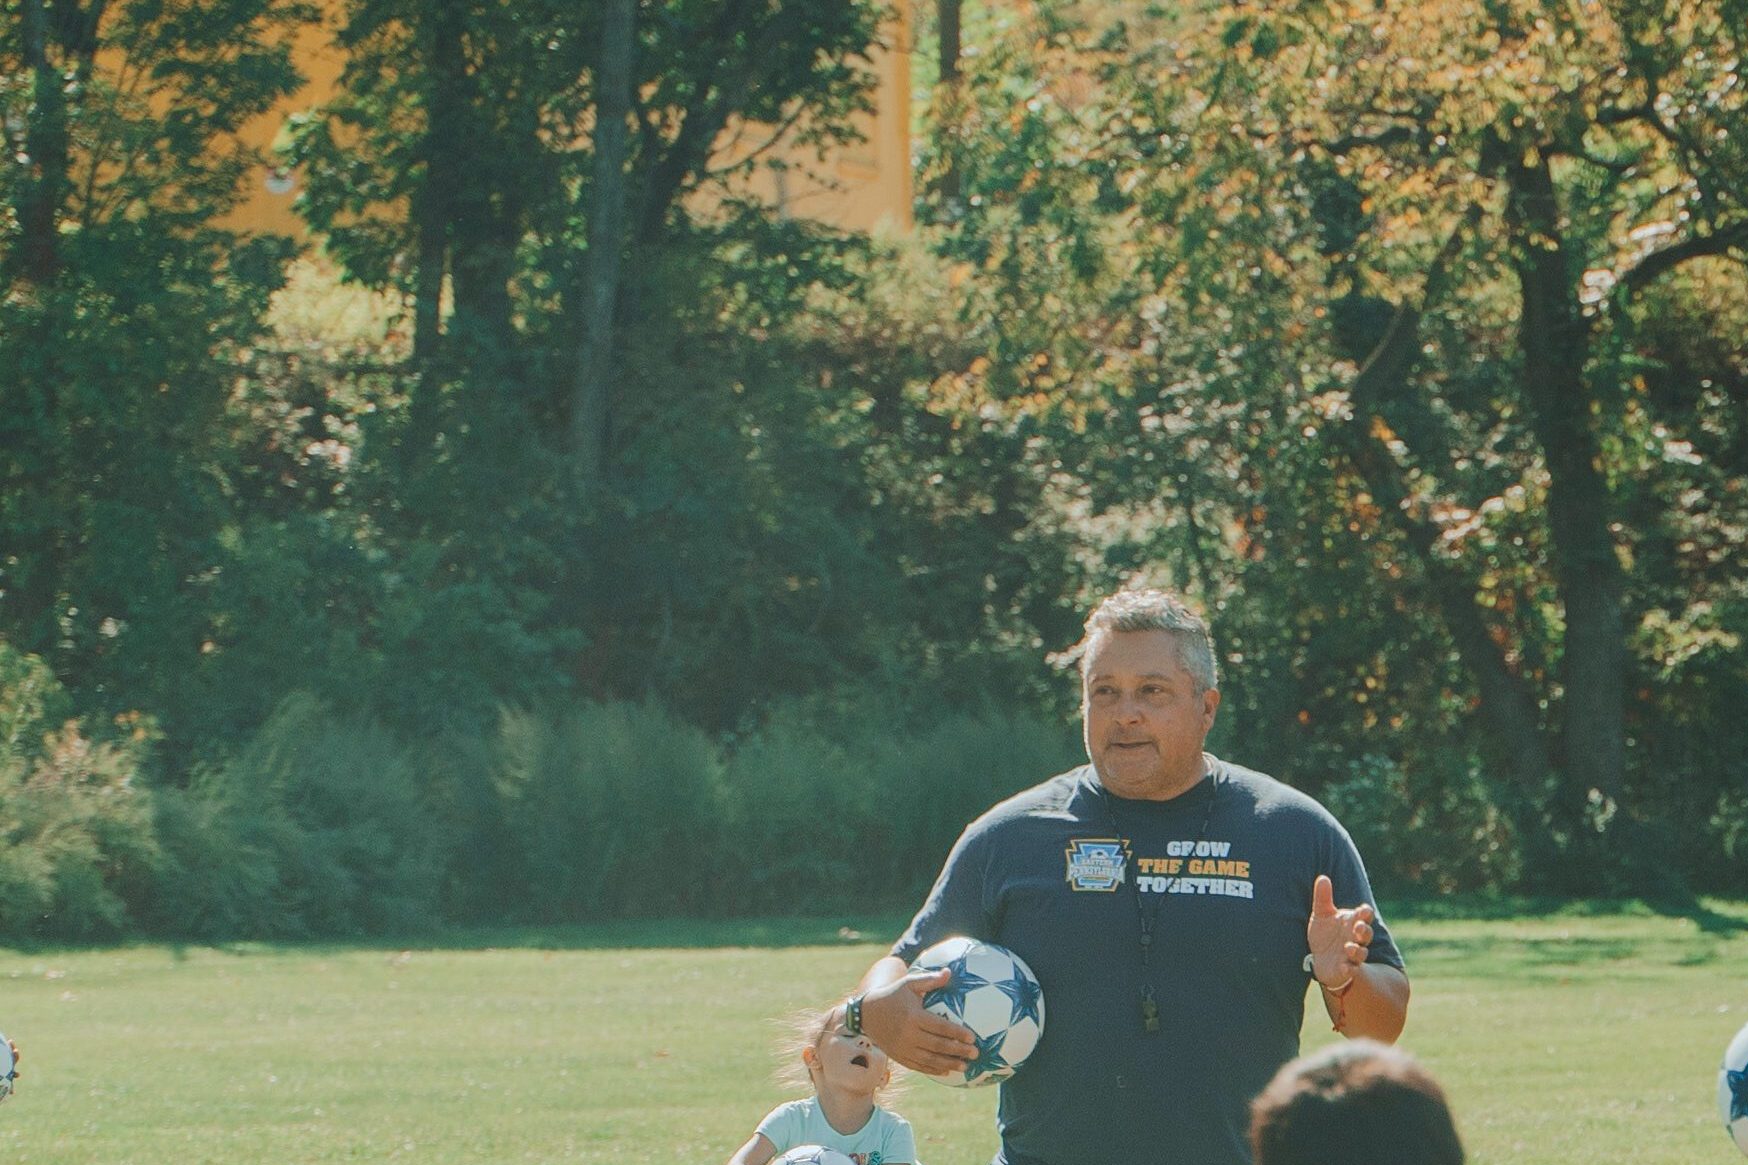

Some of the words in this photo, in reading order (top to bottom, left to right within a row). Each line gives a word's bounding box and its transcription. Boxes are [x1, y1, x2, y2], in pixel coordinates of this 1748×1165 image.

[1167, 841, 1231, 858] GROW
[1138, 858, 1183, 874] THE
[1188, 859, 1250, 878] GAME
[1137, 876, 1254, 899] TOGETHER
